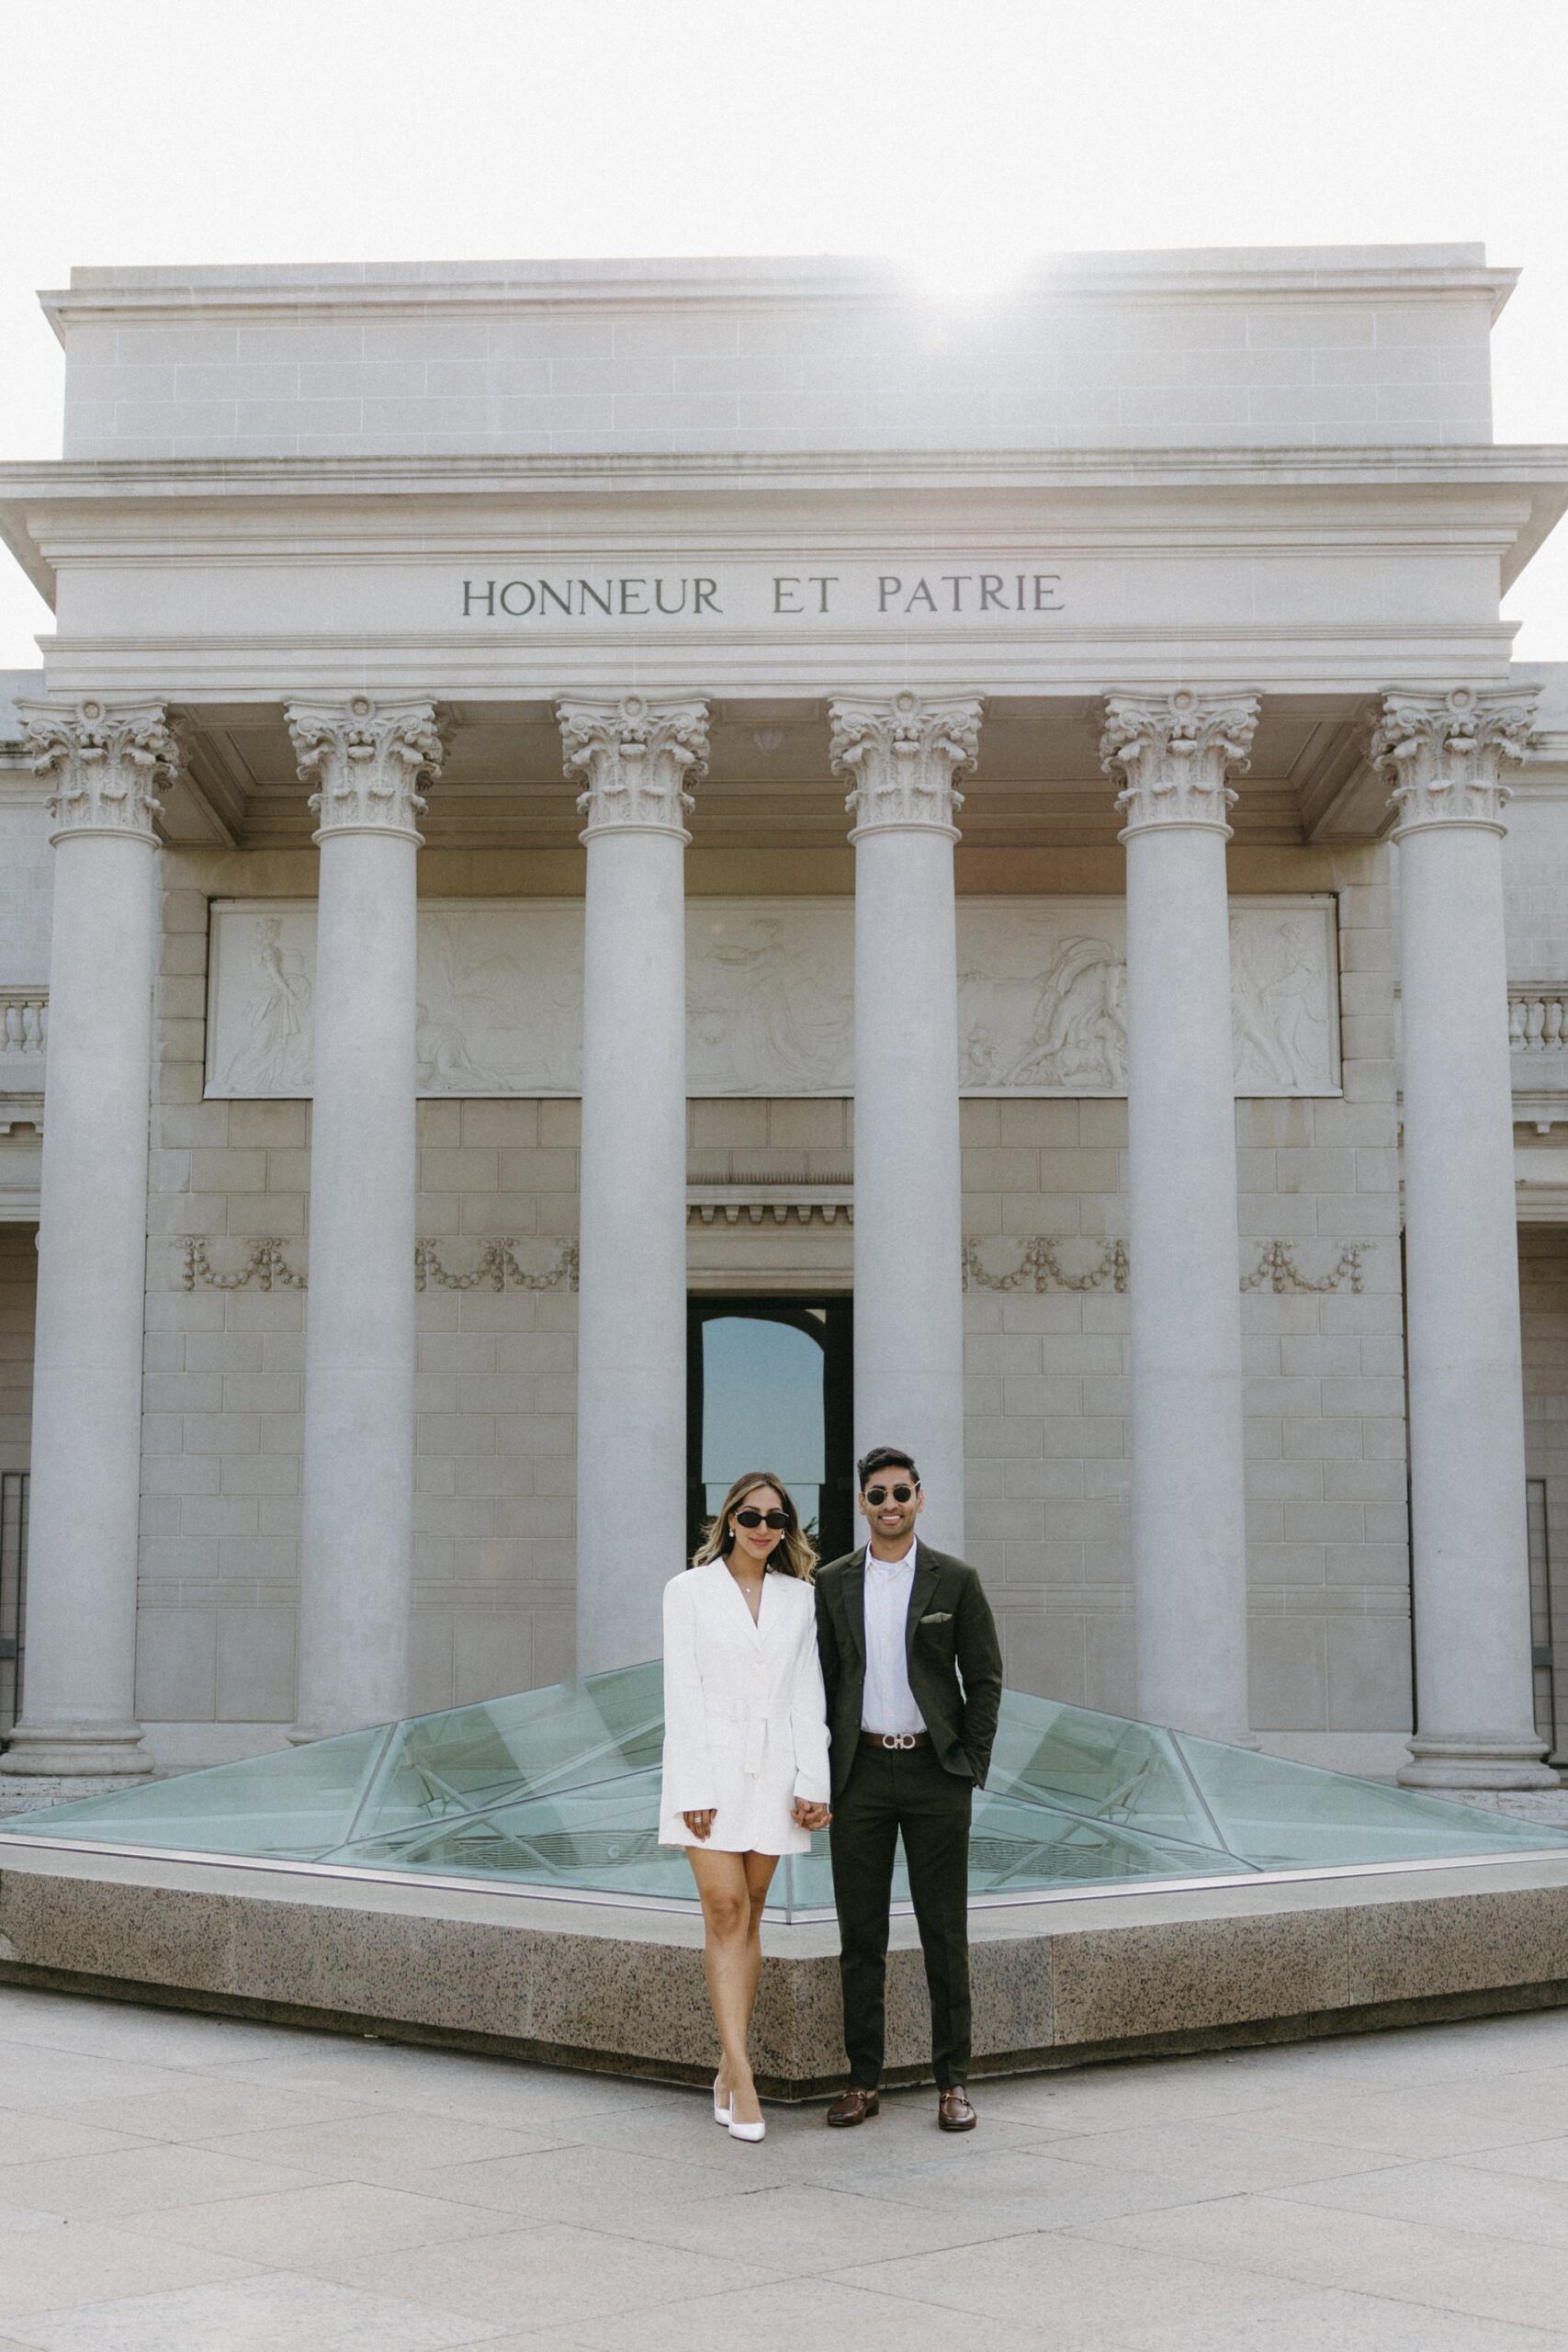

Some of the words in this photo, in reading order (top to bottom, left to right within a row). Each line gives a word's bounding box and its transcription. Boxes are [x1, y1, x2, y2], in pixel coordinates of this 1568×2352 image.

[462, 578, 723, 616] HONNEUR
[773, 577, 840, 614] ET
[877, 574, 1066, 613] PATRIE
